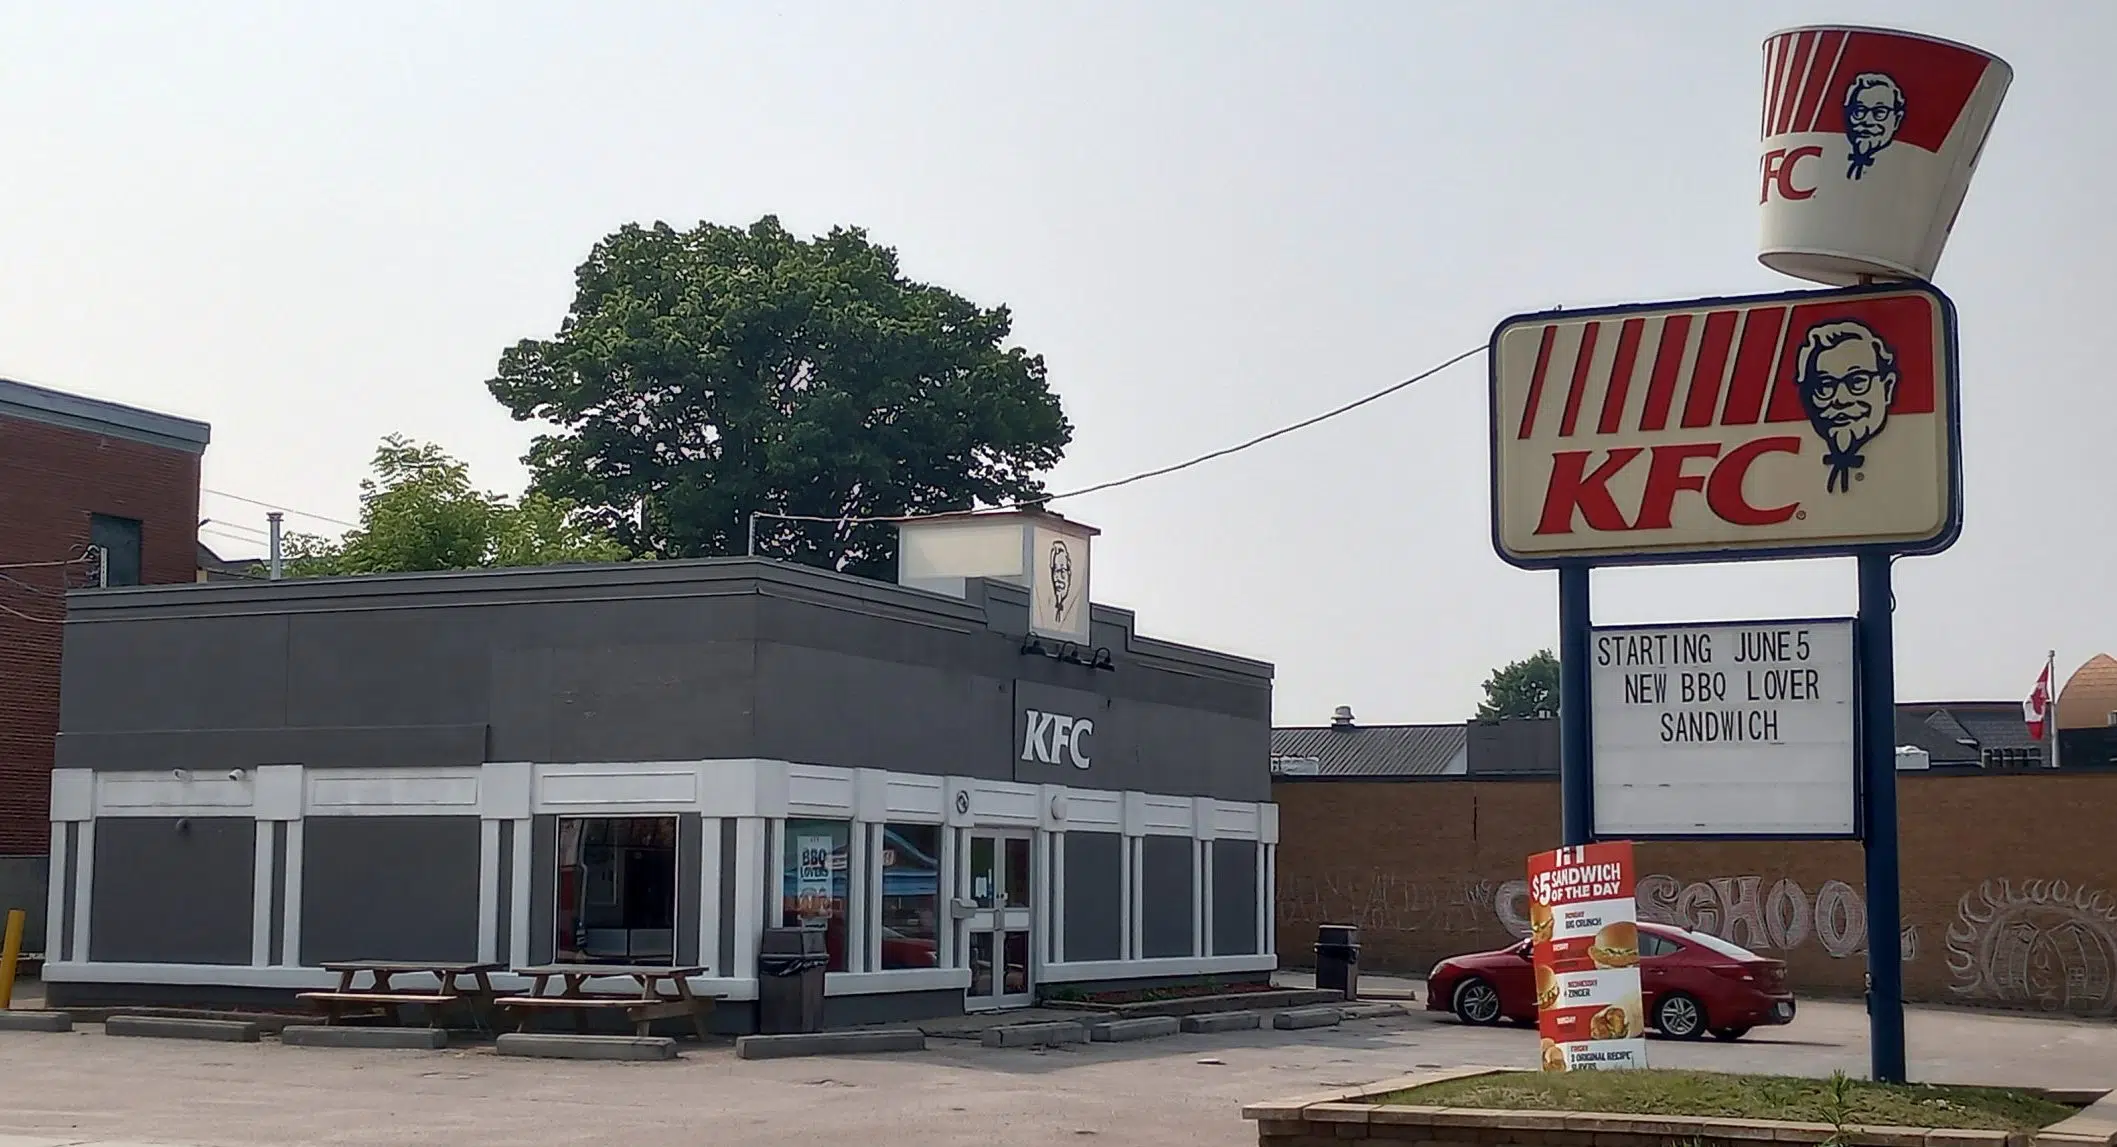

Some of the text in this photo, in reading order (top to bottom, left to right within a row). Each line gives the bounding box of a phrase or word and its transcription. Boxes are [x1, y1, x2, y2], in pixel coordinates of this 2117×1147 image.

[1759, 145, 1823, 206] FC
[1532, 435, 1802, 535] KFC
[1597, 633, 1712, 666] STARTING
[1624, 669, 1820, 704] NEW BBQ LOVER
[1020, 709, 1095, 770] KFC
[1660, 710, 1779, 742] SANDWICH
[802, 848, 827, 868] BBQ
[1551, 862, 1621, 888] SANDWICH
[1532, 871, 1551, 906] $5
[1551, 881, 1621, 902] OF THE DAY
[1635, 874, 1919, 960] SCHOO
